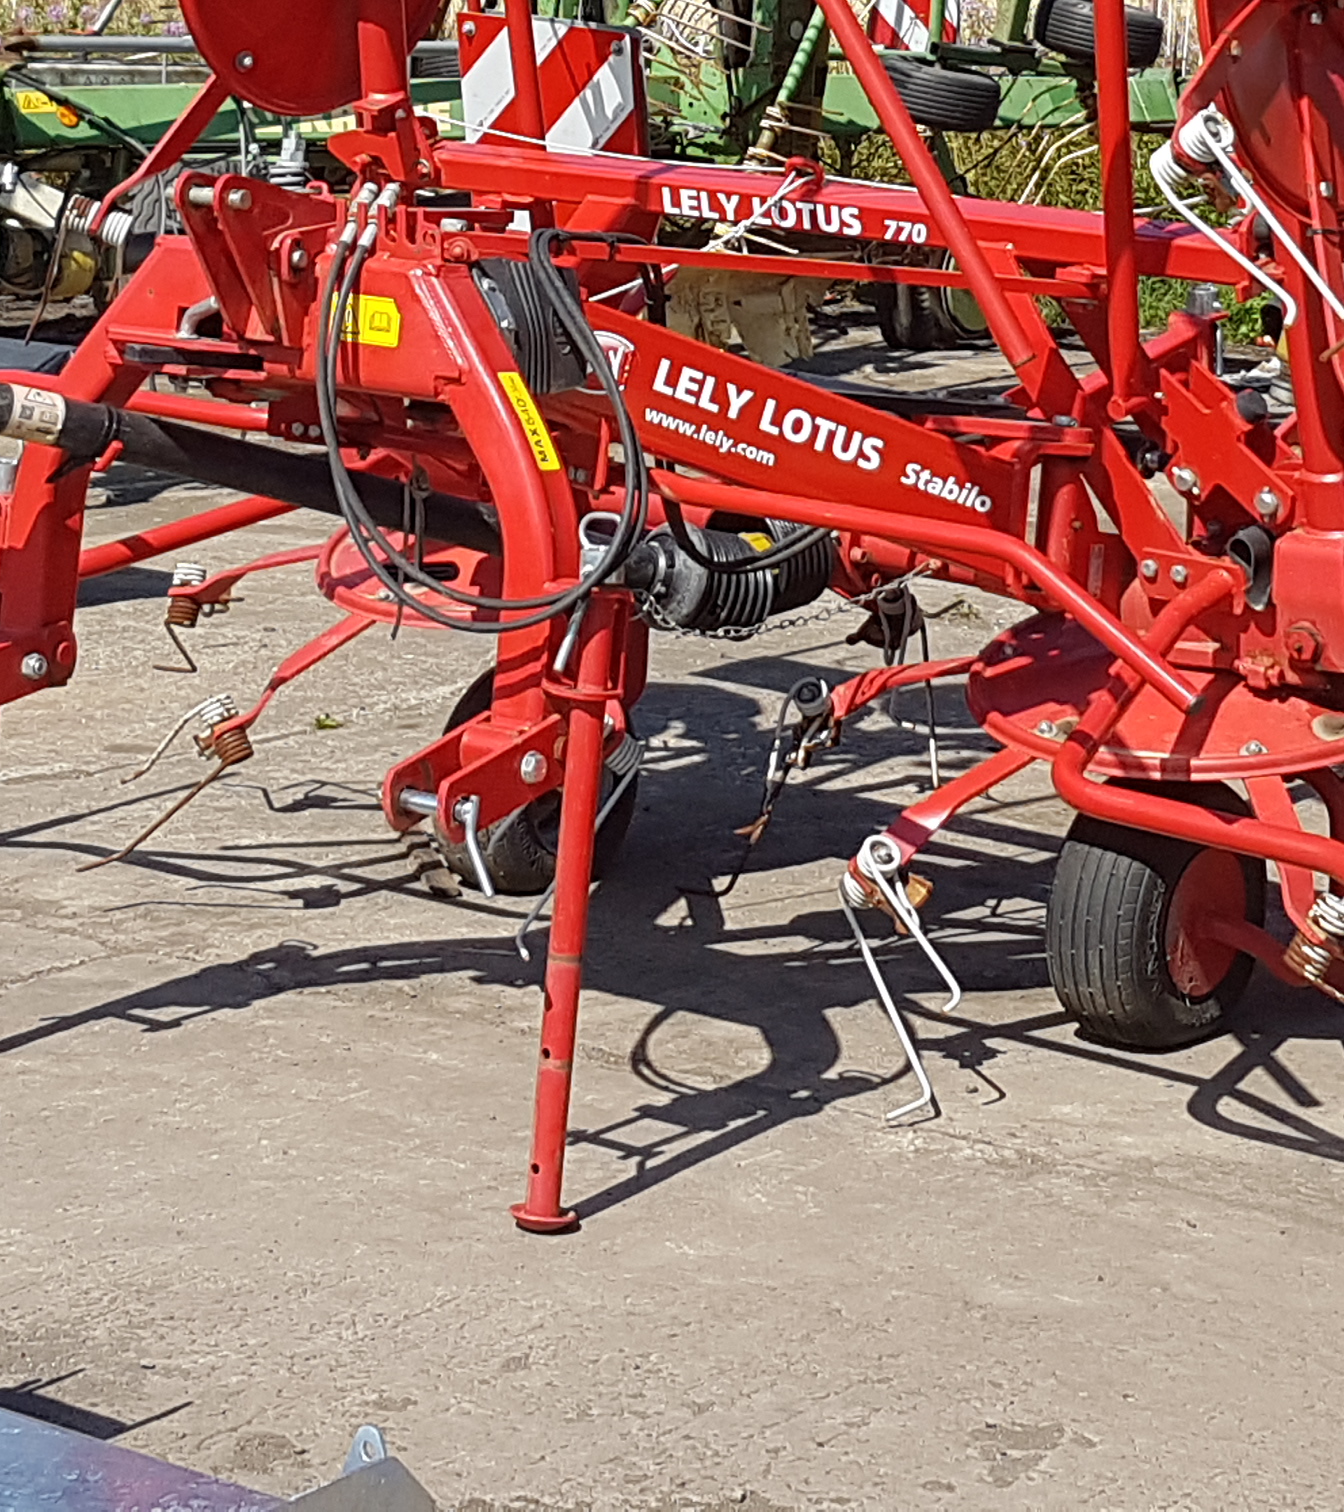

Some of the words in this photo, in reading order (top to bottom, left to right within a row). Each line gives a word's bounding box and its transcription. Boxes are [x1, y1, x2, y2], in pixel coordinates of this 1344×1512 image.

[661, 186, 740, 221] LELY
[752, 196, 862, 236] LOTUS
[883, 219, 927, 244] 770
[644, 407, 776, 466] www.lely.com
[652, 357, 755, 420] LELY
[758, 398, 886, 471] LOTUS
[900, 462, 992, 513] Stabilo
